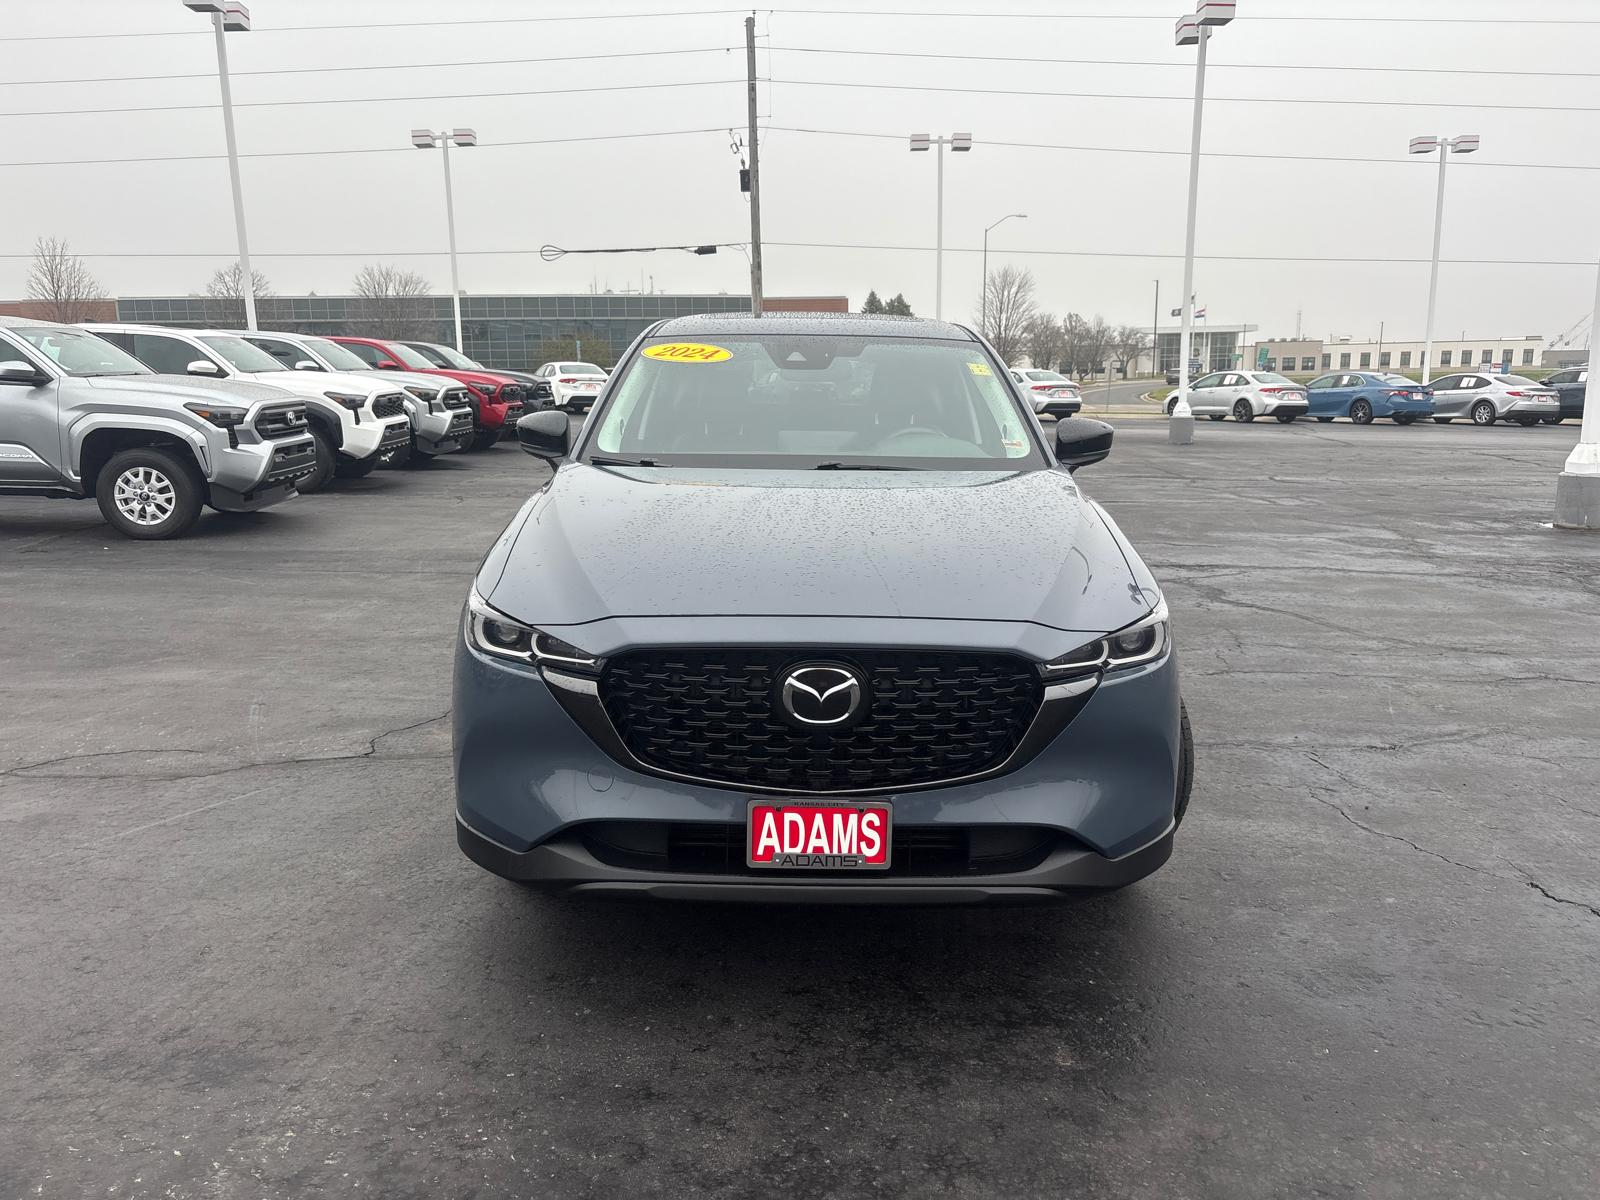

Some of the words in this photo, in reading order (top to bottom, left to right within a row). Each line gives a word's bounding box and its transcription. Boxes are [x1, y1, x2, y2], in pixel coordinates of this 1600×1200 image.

[653, 346, 721, 359] 2024
[757, 812, 881, 857] ADAMS
[781, 854, 858, 867] ADAMS
